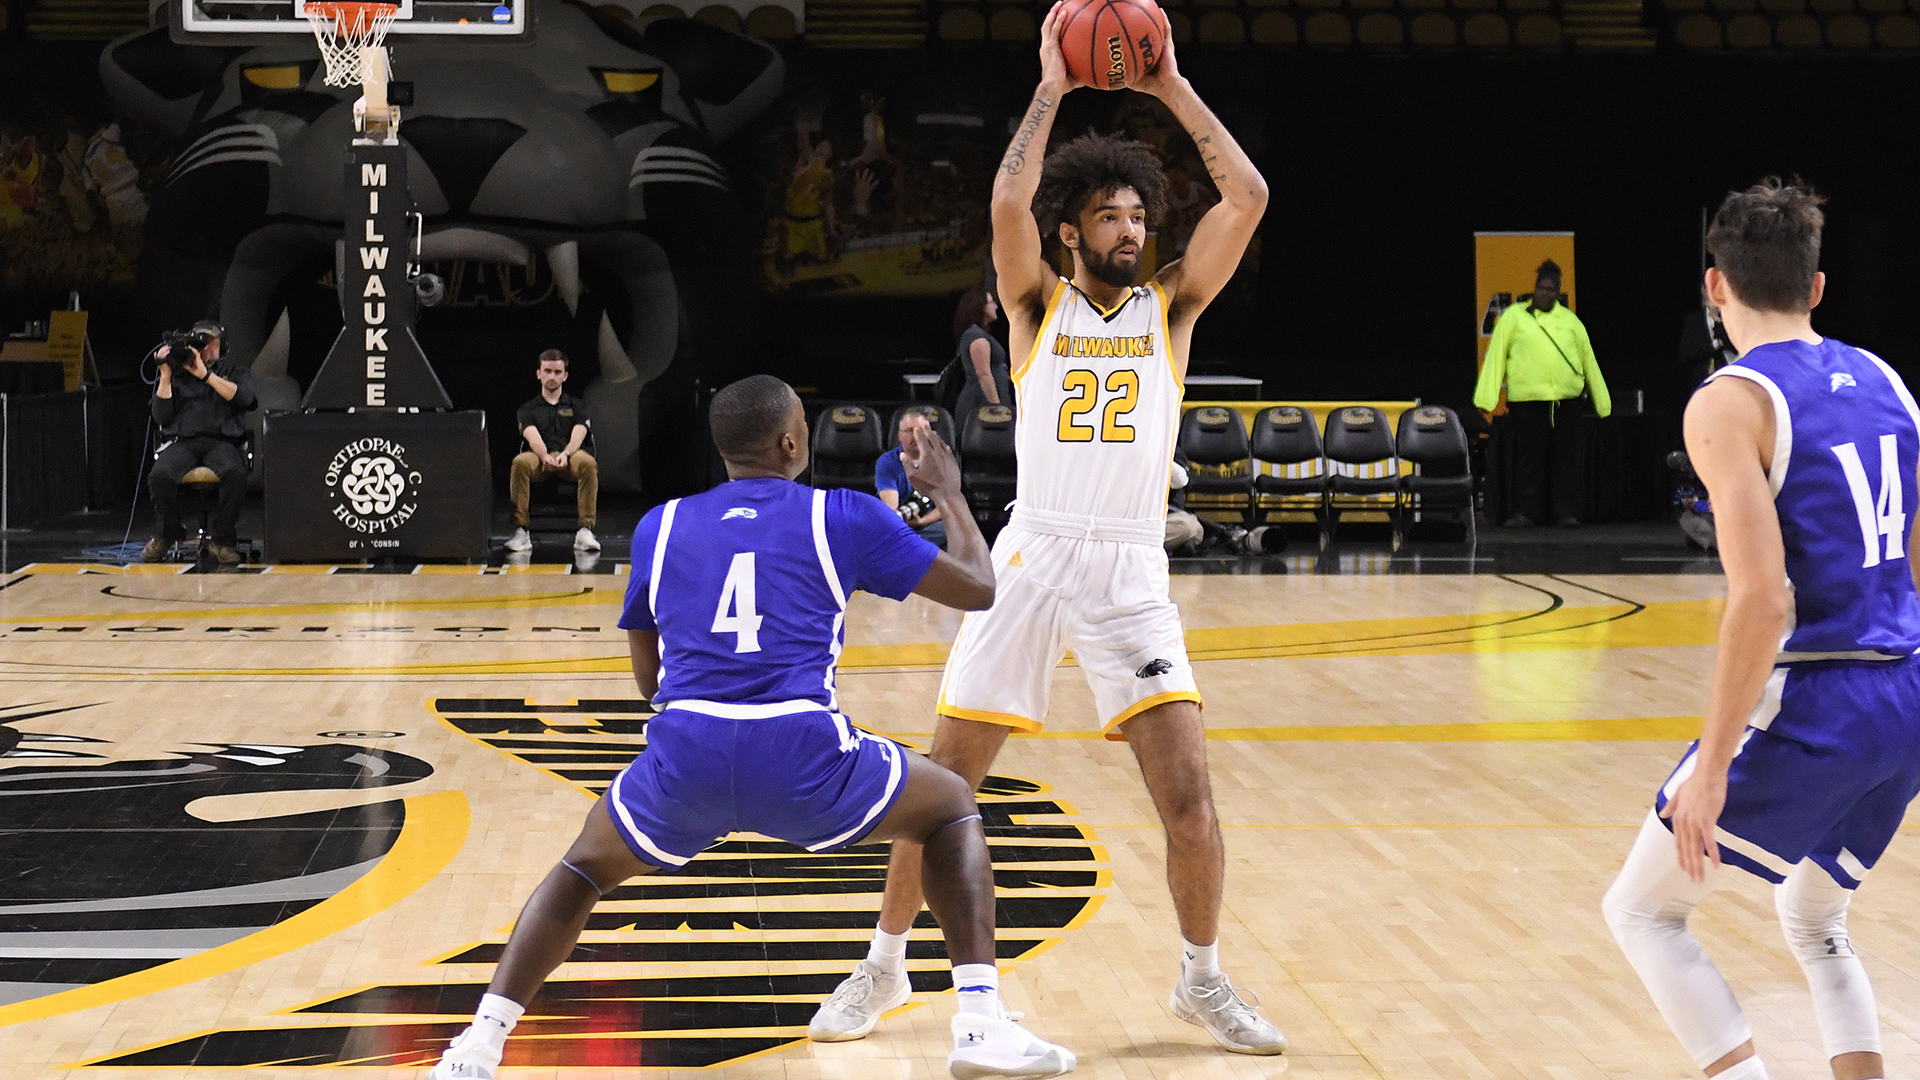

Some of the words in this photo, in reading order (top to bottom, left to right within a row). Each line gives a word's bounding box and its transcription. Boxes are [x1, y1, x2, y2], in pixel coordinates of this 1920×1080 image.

[1139, 33, 1155, 72] CAA
[359, 163, 389, 406] MILWAUKEE
[1052, 333, 1154, 358] MLWAUKE
[1057, 369, 1140, 442] 22
[325, 437, 422, 487] ORTHOPAEC
[332, 503, 417, 533] HOSPITAL
[1830, 434, 1906, 568] 14
[361, 540, 399, 548] CONSIN
[711, 552, 763, 653] 4
